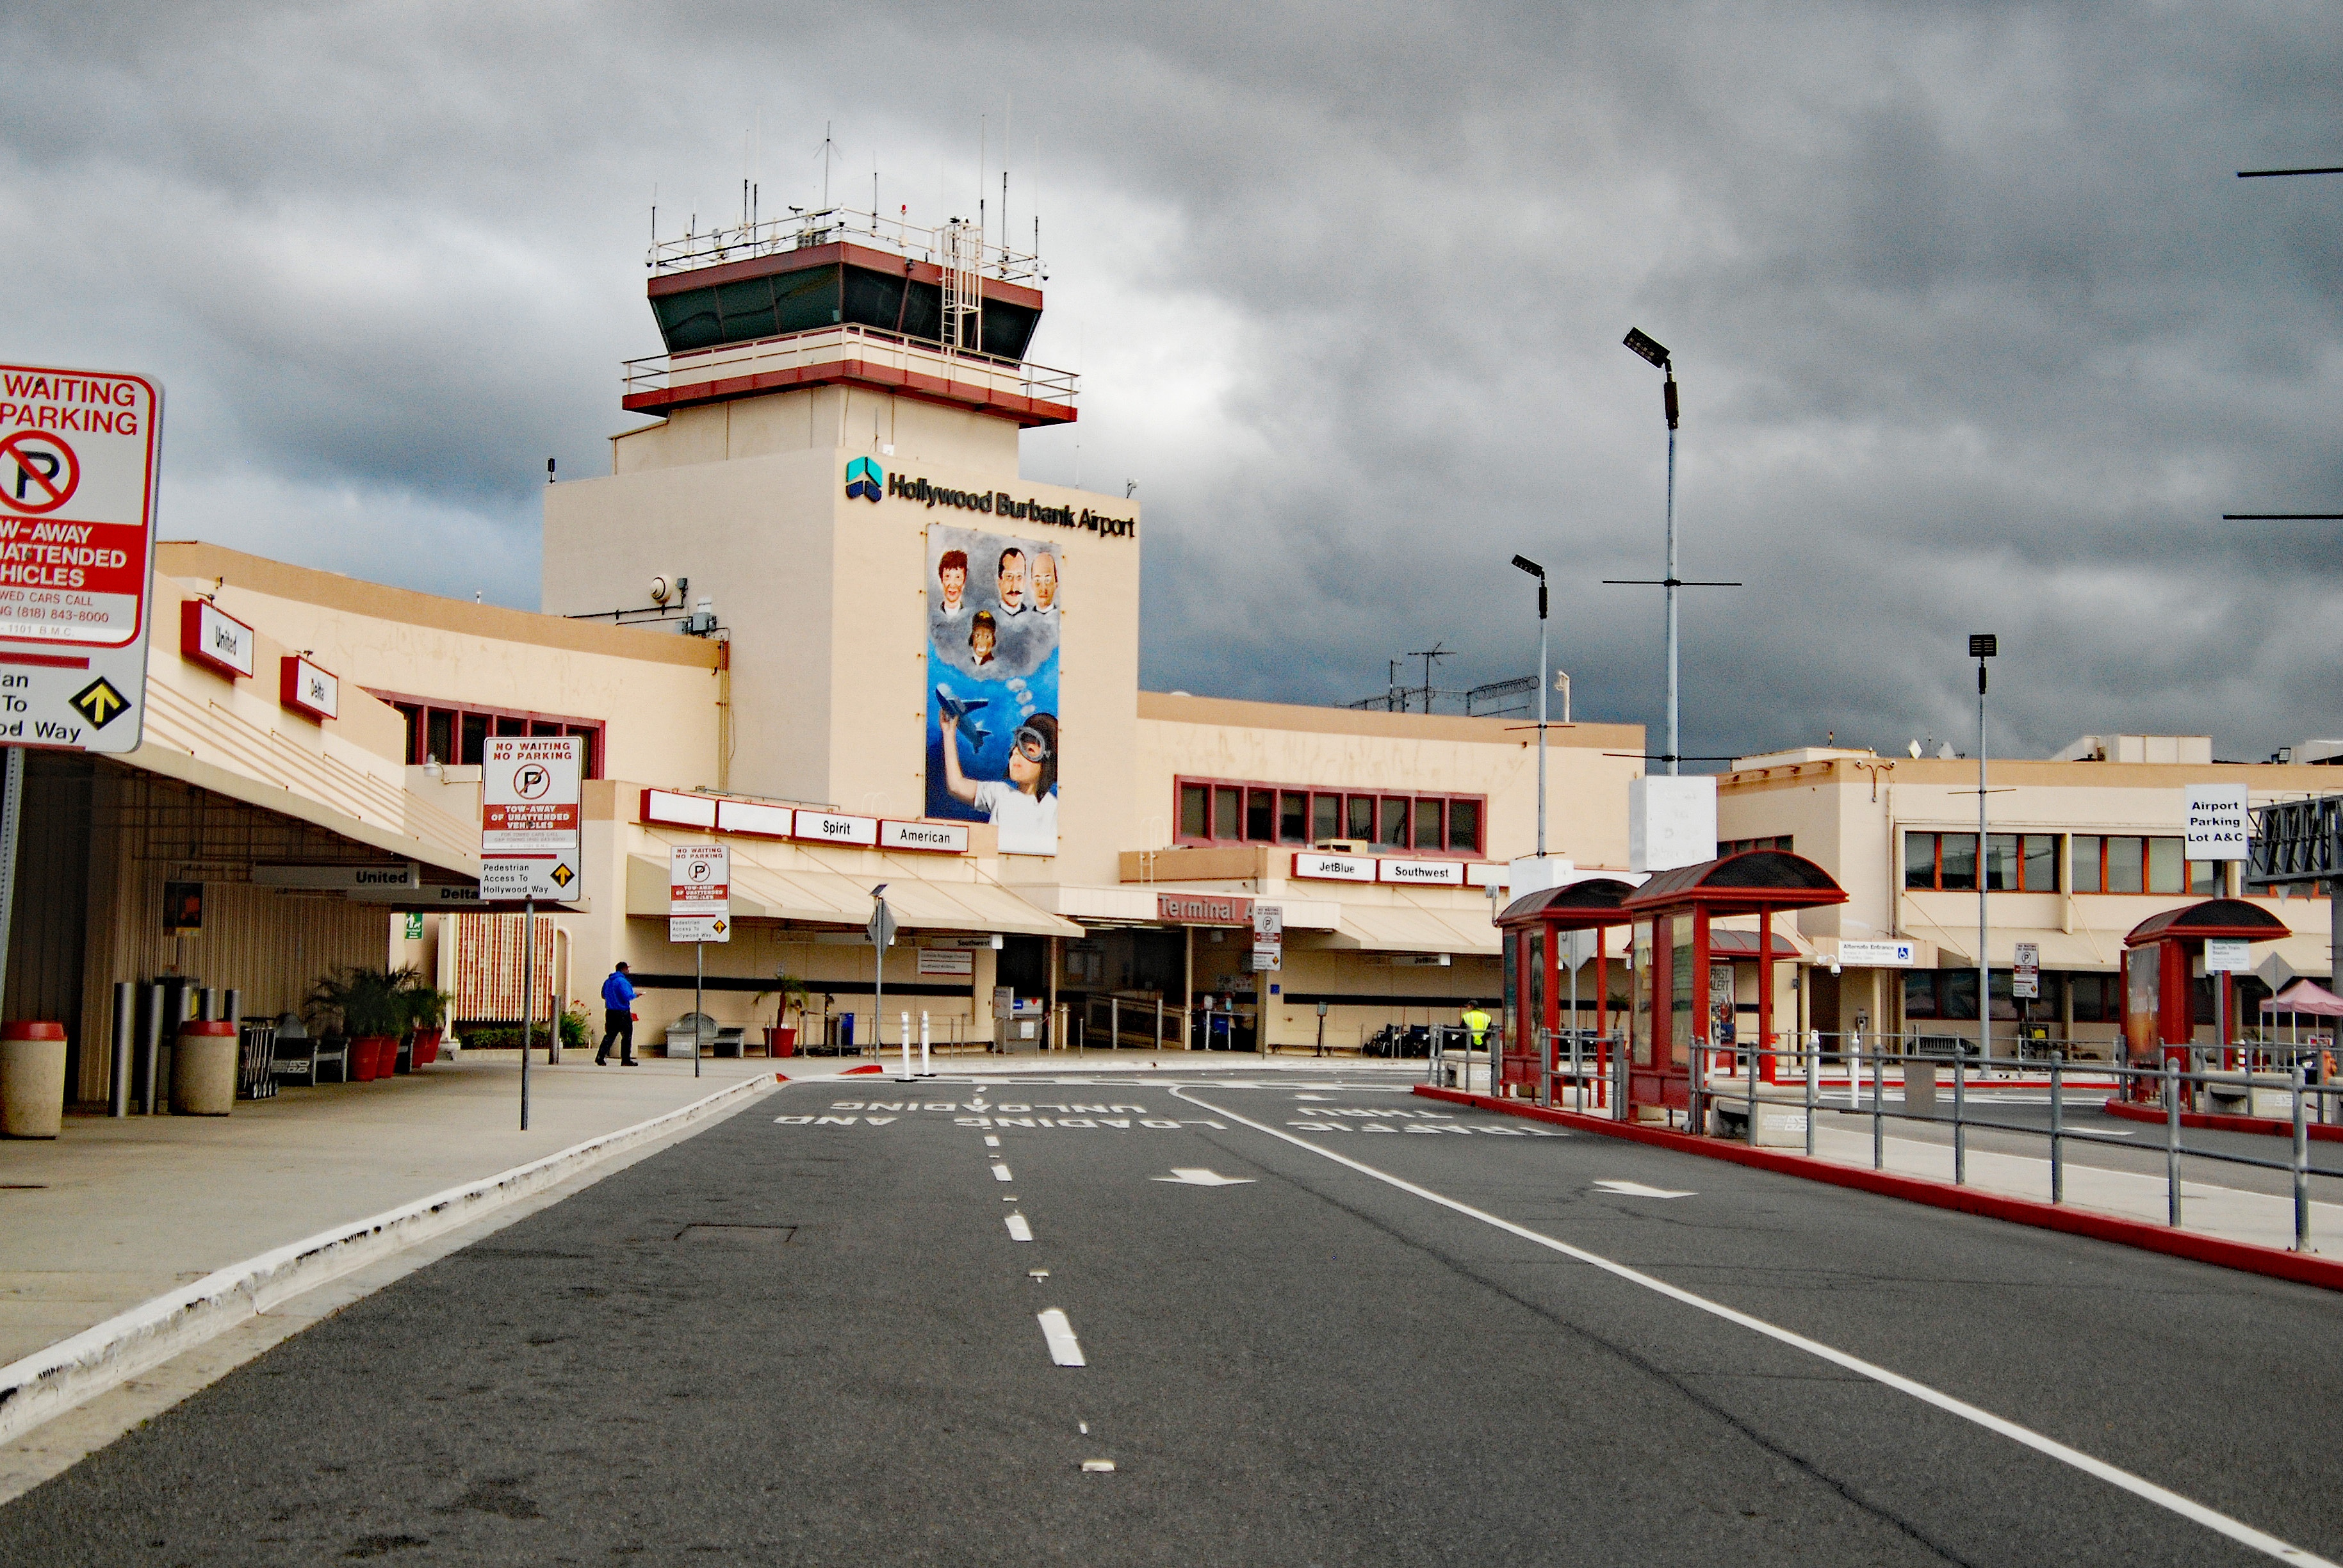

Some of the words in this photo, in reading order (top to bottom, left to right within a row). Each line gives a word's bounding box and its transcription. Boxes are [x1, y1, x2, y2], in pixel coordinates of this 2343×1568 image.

[4, 374, 136, 406] WAITING
[0, 402, 137, 436] PARKING
[888, 472, 993, 513] Hollywood
[995, 492, 1075, 528] Burbank
[1078, 507, 1134, 538] Airport
[29, 592, 60, 604] CARS
[65, 594, 93, 607] CALL
[18, 605, 45, 619] (818)
[51, 609, 109, 623] 843-8000
[216, 625, 237, 656] United
[3, 694, 27, 712] To
[35, 721, 81, 744] Way
[519, 742, 570, 751] WAITING
[517, 752, 572, 760] PARKING
[2192, 802, 2239, 812] Airport
[823, 821, 851, 836] Spirit
[2191, 817, 2240, 828] Parking
[900, 828, 951, 844] American
[2188, 833, 2208, 842] Lot
[2214, 833, 2243, 842] A&C
[1319, 862, 1355, 874] JetBlue
[1395, 866, 1449, 878] Southwest
[356, 871, 408, 883] United
[441, 888, 479, 900] Delta
[484, 885, 527, 895] Hollywood
[531, 885, 549, 894] Way
[1158, 894, 1237, 920] Terminal
[1243, 899, 1255, 921] A
[829, 1102, 1148, 1114] UNLOADING
[771, 1115, 898, 1127] AND
[954, 1117, 1228, 1130] LOADING
[1286, 1122, 1571, 1137] TRAFFIC
